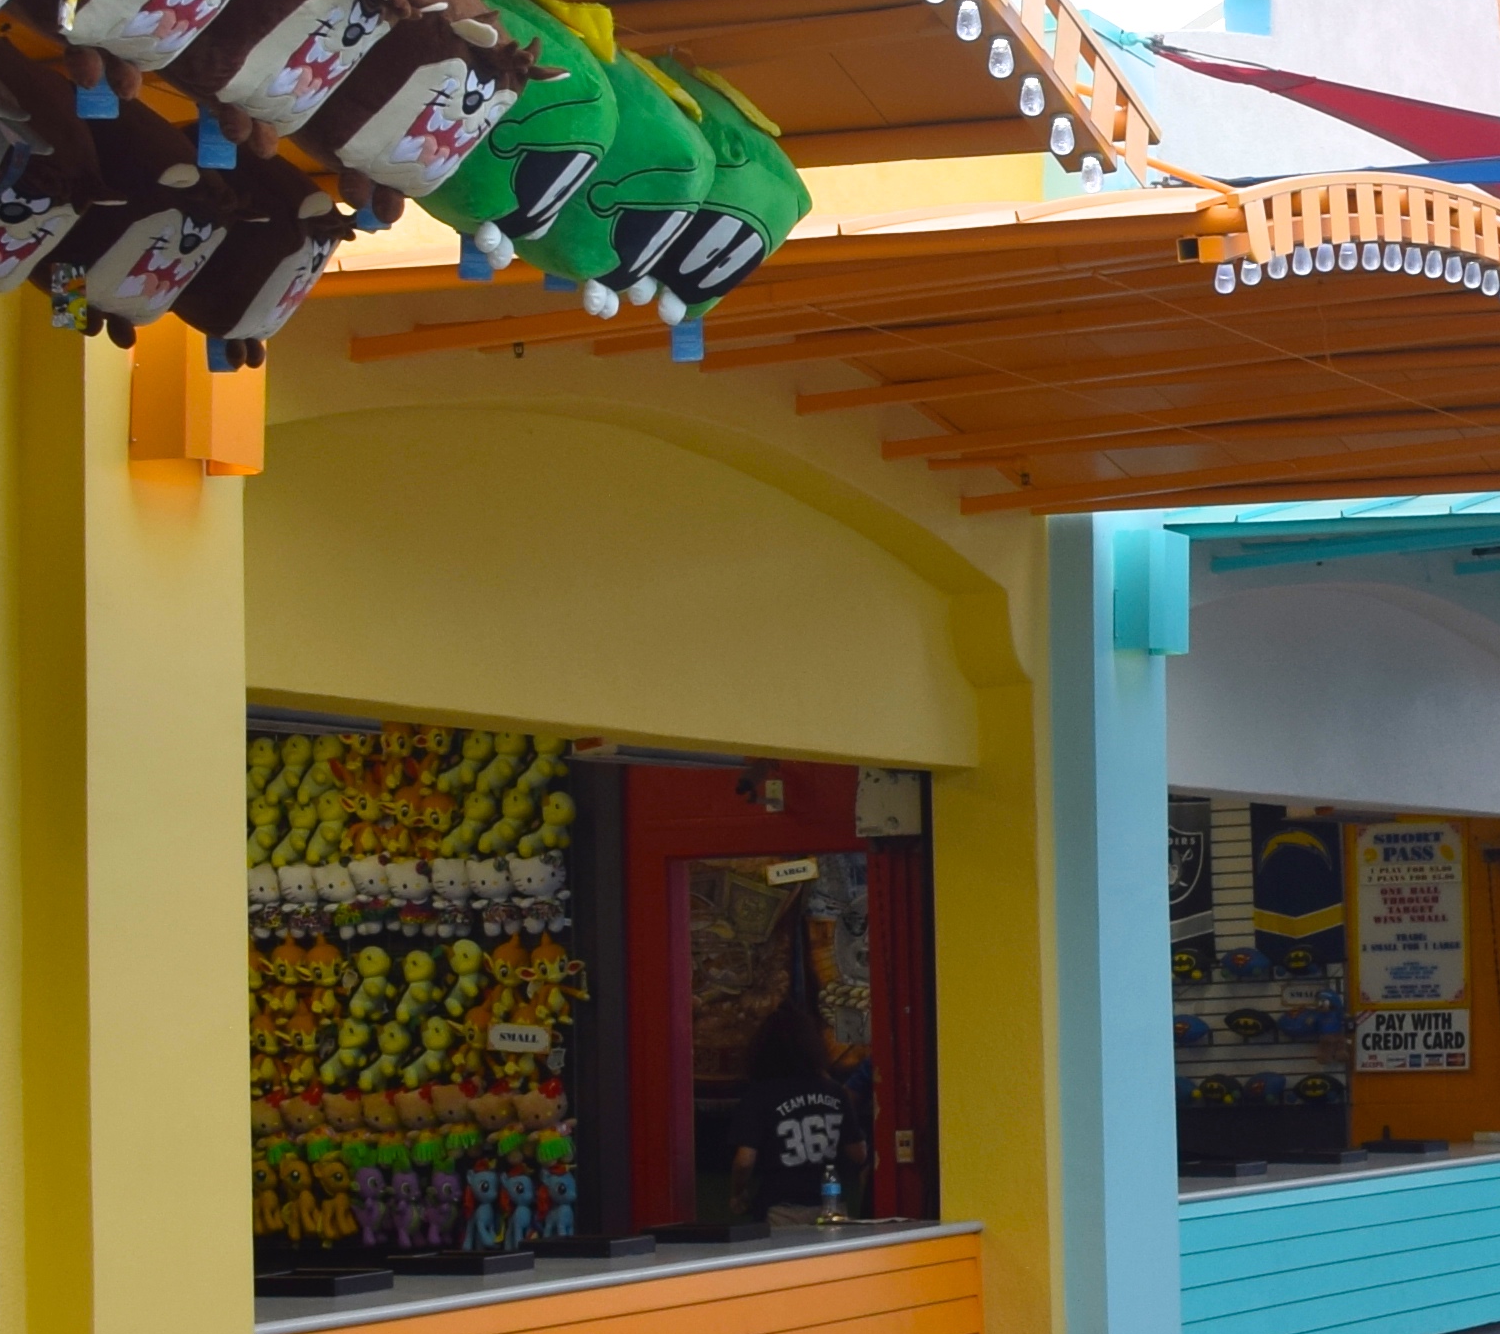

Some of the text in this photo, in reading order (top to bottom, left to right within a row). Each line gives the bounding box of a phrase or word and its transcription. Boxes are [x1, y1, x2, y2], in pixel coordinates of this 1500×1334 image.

[1373, 832, 1443, 844] SHORT
[1383, 846, 1433, 862] PASS
[776, 866, 808, 877] LARGE
[1373, 915, 1448, 924] WINS SMALL
[1375, 1013, 1406, 1031] PAY
[1411, 1012, 1452, 1031] WITH
[499, 1032, 539, 1043] SMALL
[1361, 1031, 1466, 1051] CREDIT CARD
[776, 1092, 841, 1118] TEAM MAGIC
[776, 1113, 843, 1168] 365
